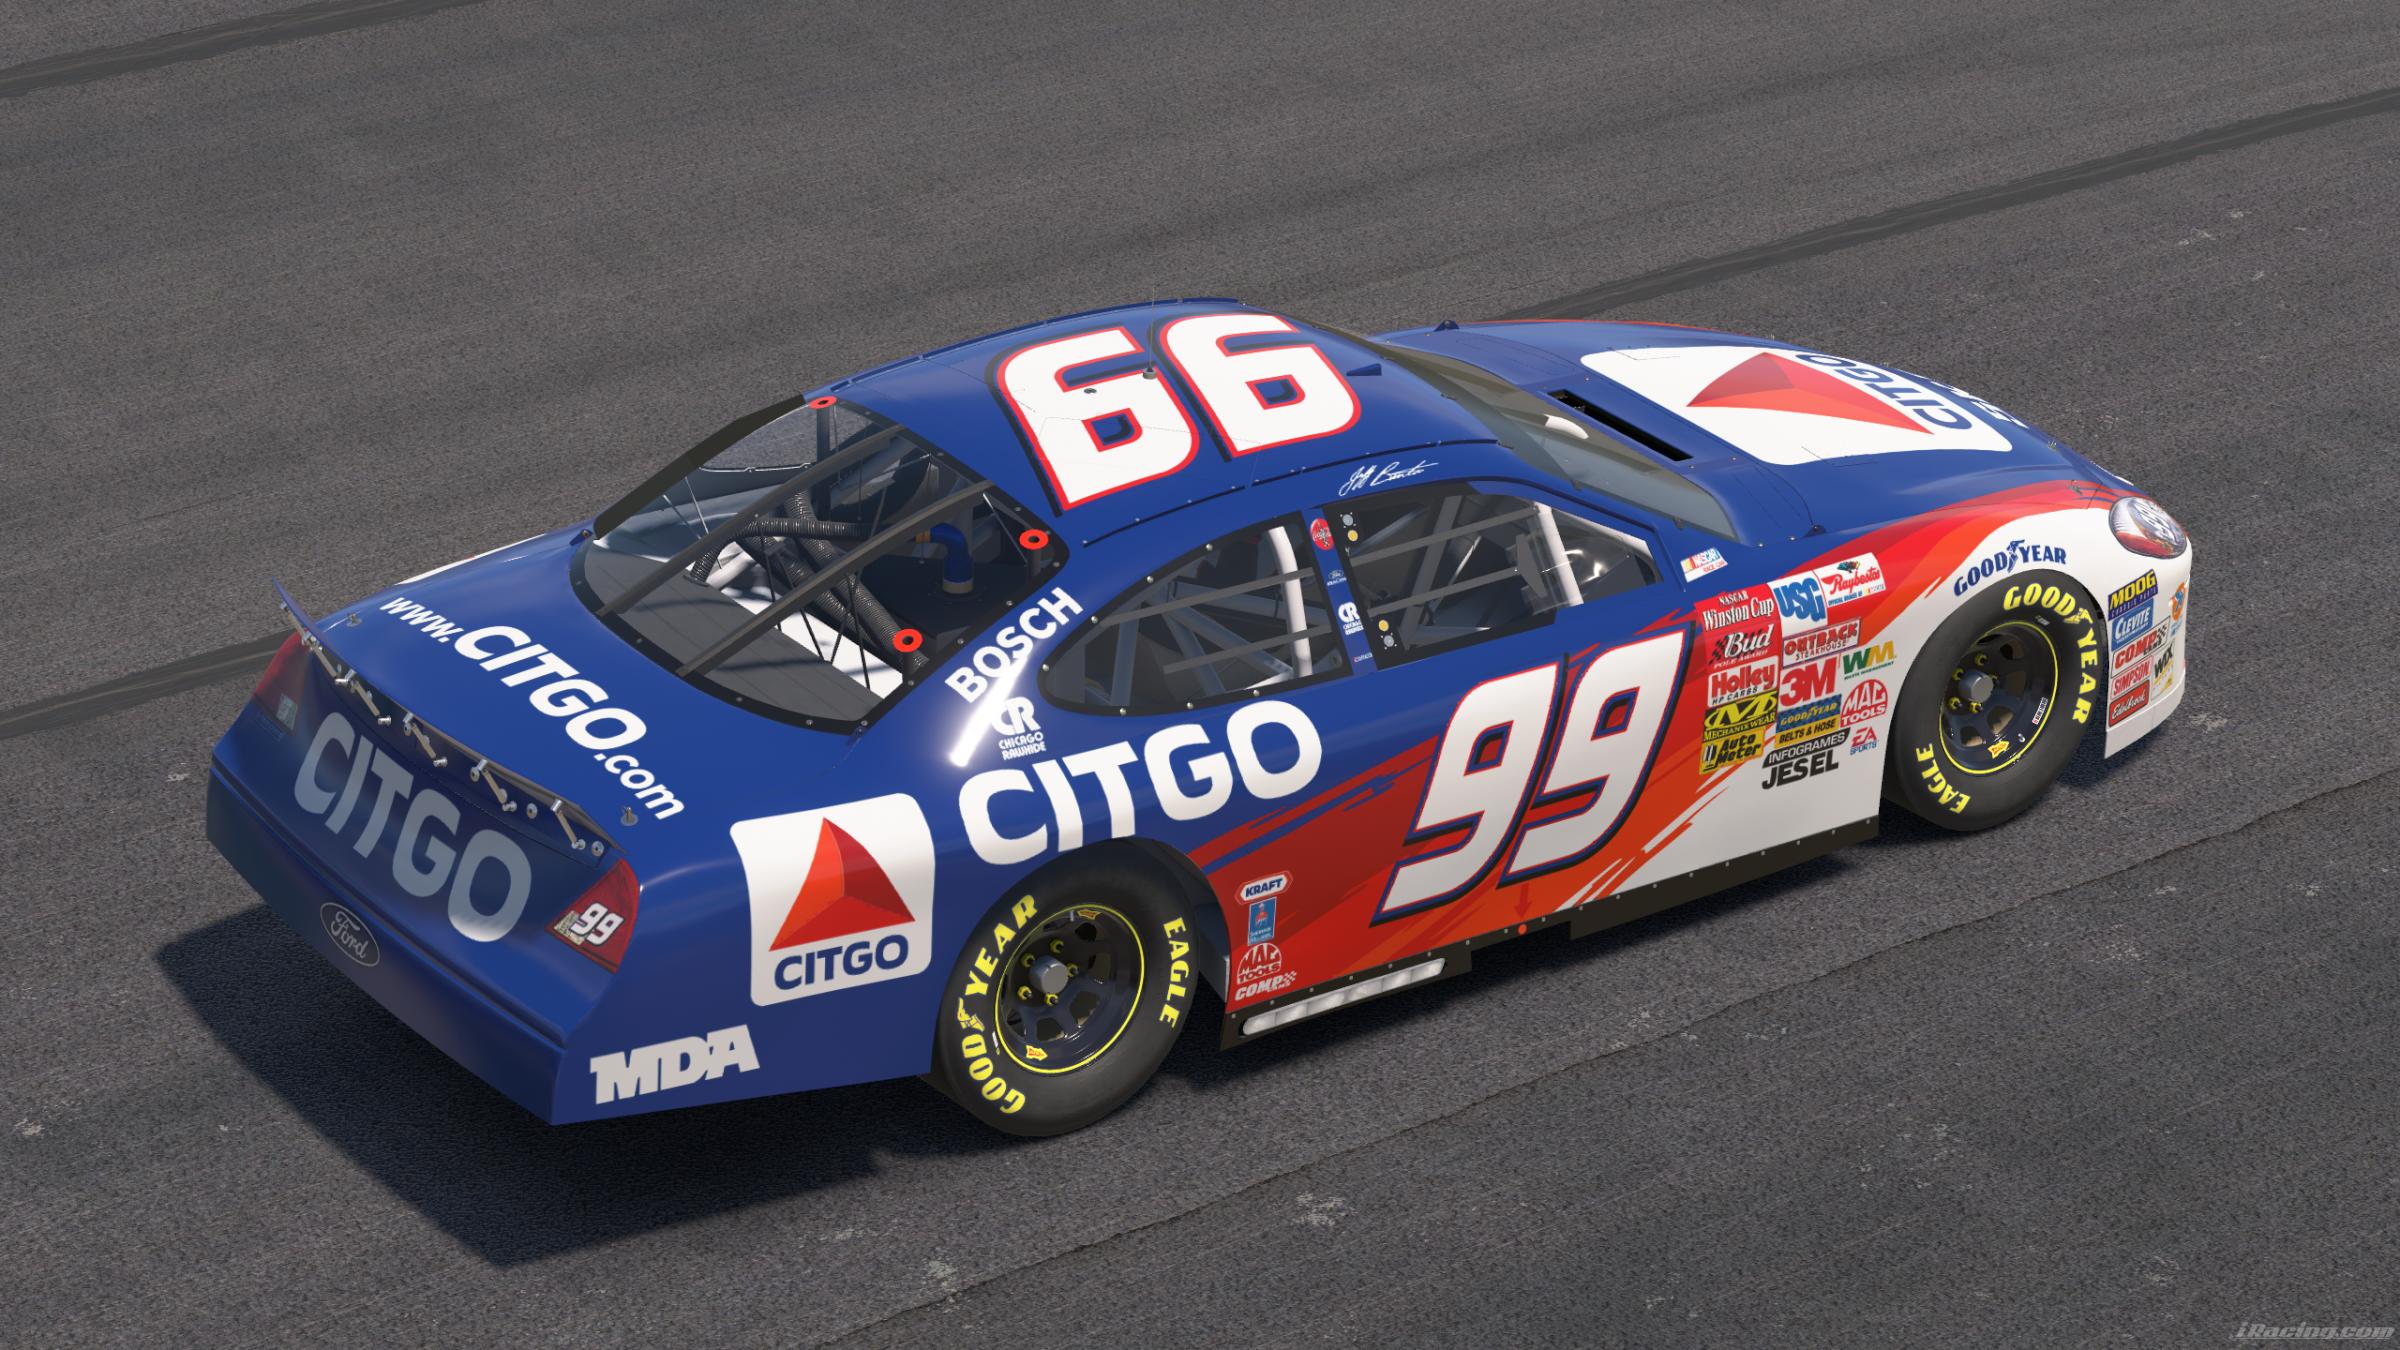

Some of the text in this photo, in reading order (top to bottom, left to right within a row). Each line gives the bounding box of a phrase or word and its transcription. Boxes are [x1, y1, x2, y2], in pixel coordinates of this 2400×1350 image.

[1796, 354, 1973, 429] CITGO
[1821, 566, 1880, 595] Raybestos
[1954, 539, 2067, 597] GOODYEAR
[1719, 590, 1749, 605] NASCAR
[1773, 576, 1827, 623] USG
[2109, 570, 2157, 610] MOOG
[1702, 597, 1774, 631] Winston Cup
[944, 586, 1083, 704] BOSCH
[1724, 623, 1775, 658] Bud
[1785, 622, 1858, 656] OUTBACK
[1795, 641, 1848, 660] STEAKHOUSE
[2003, 583, 2097, 724] GOODYEAR
[2114, 630, 2157, 670] COMP
[1711, 662, 1776, 699] Holley
[1727, 686, 1758, 701] CARBS
[1780, 656, 1837, 707] 3M
[2113, 660, 2150, 696] SIMPSON
[1781, 702, 1837, 726] GOODYEAR
[1843, 680, 1886, 715] MAC
[1703, 712, 1776, 741] MECHANIX WEAR
[1779, 730, 1805, 744] BELTS
[1813, 719, 1835, 734] HOSE
[1841, 704, 1887, 728] TOOLS
[998, 731, 1044, 750] CHICAGO
[1001, 742, 1047, 760] RAWHIDE
[1721, 733, 1756, 751] Auto
[1768, 732, 1846, 764] INFOGRAMES
[1850, 741, 1877, 755] SPORTS
[1852, 727, 1877, 747] EA
[959, 700, 1322, 865] CITGO
[1369, 620, 1695, 927] 99
[1761, 749, 1839, 790] JESEL
[1916, 743, 1971, 814] EAGLE
[294, 712, 532, 942] CITGO
[1245, 878, 1283, 898] KRAFT
[331, 911, 368, 958] Ford
[569, 902, 625, 946] 99
[773, 934, 909, 990] CITGO
[1159, 917, 1190, 1028] EAGLE
[957, 894, 1038, 1114] GOODYEAR
[1235, 974, 1284, 1001] COMP
[590, 1024, 760, 1104] MDA
